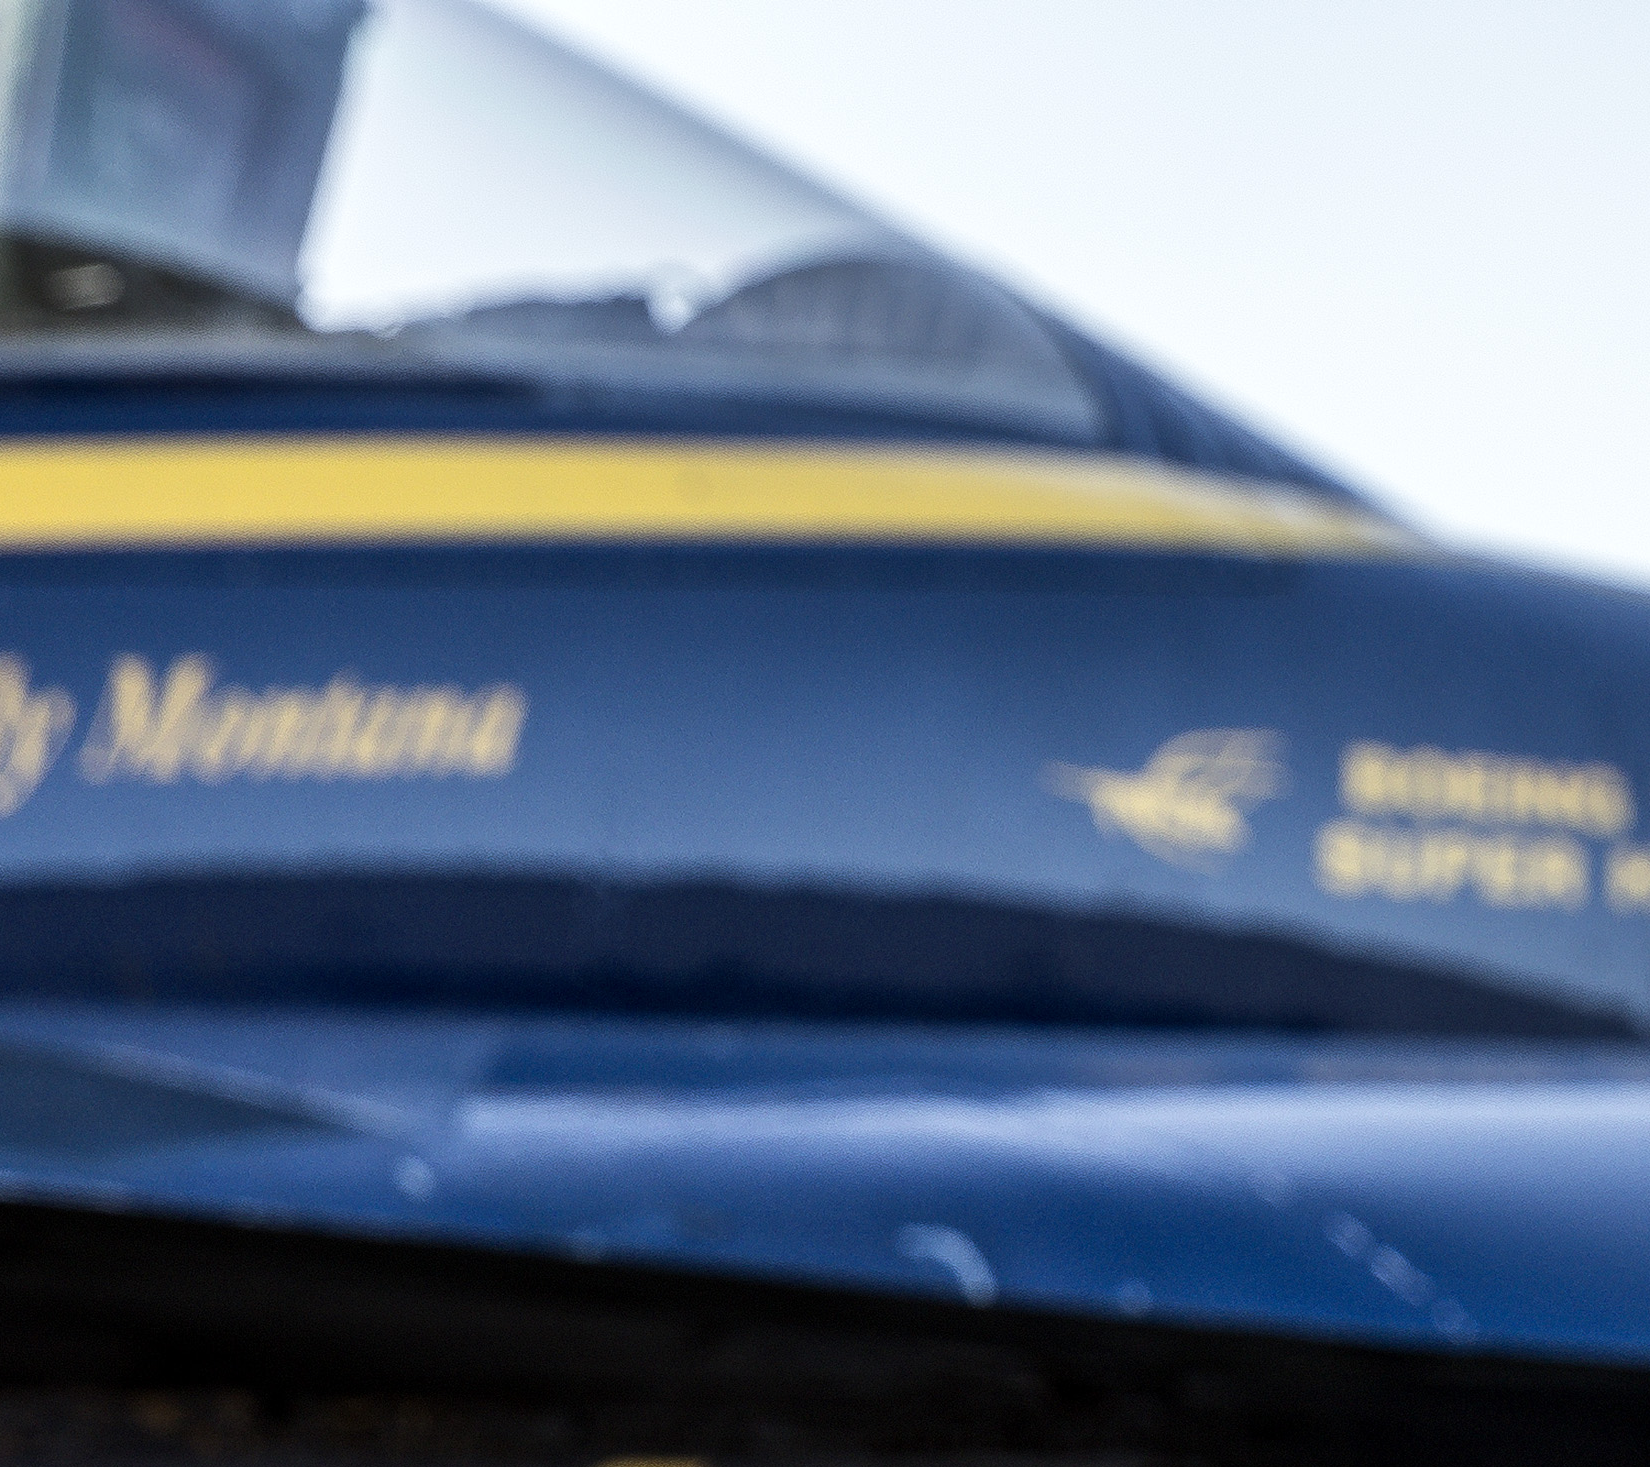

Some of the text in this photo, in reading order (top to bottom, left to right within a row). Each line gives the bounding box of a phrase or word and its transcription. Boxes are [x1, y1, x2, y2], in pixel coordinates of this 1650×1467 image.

[82, 652, 527, 785] Montana
[1338, 740, 1633, 837] BOEING
[1313, 818, 1590, 909] SUPER
